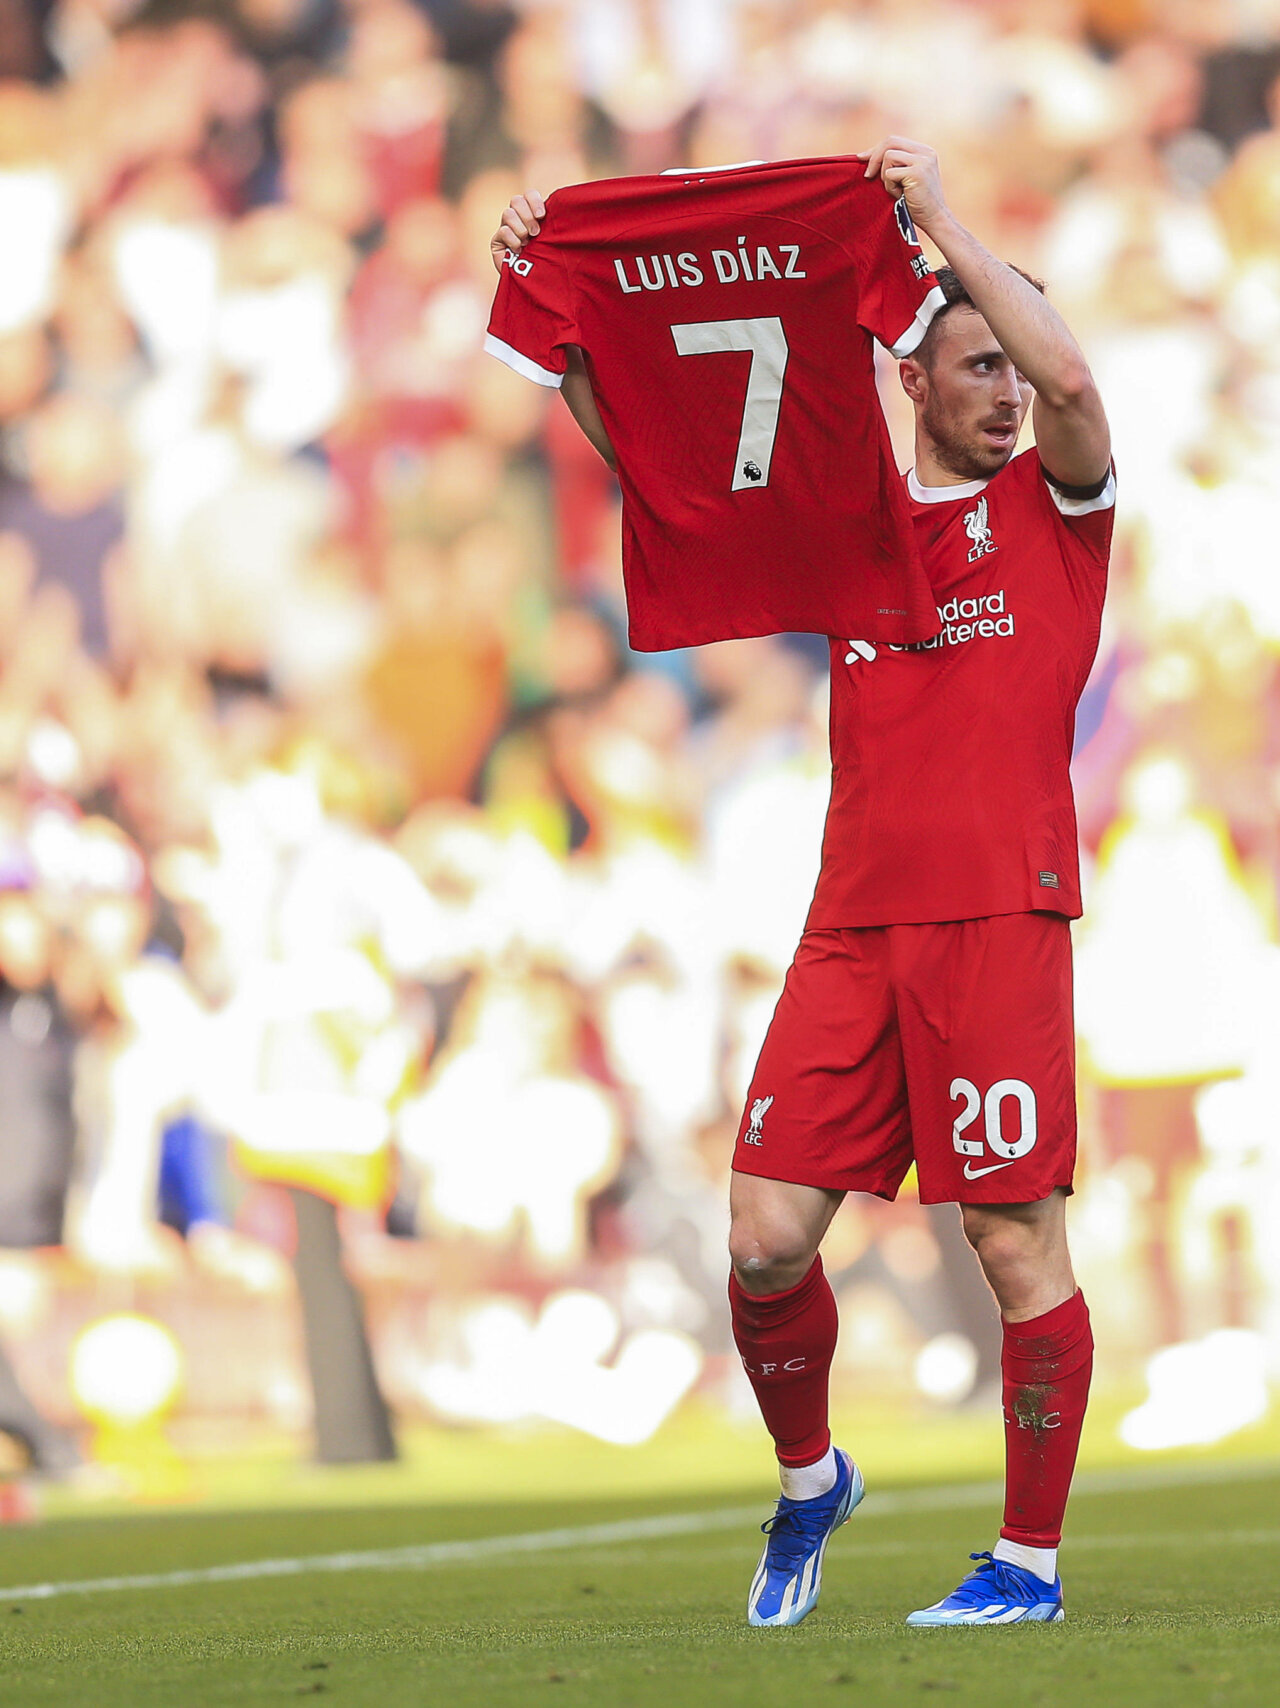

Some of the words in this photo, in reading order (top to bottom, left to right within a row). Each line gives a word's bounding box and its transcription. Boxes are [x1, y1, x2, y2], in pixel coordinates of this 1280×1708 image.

[613, 252, 704, 294] LUIS
[711, 236, 807, 284] DÍAZ
[670, 316, 789, 492] 7
[949, 1077, 1038, 1160] 20
